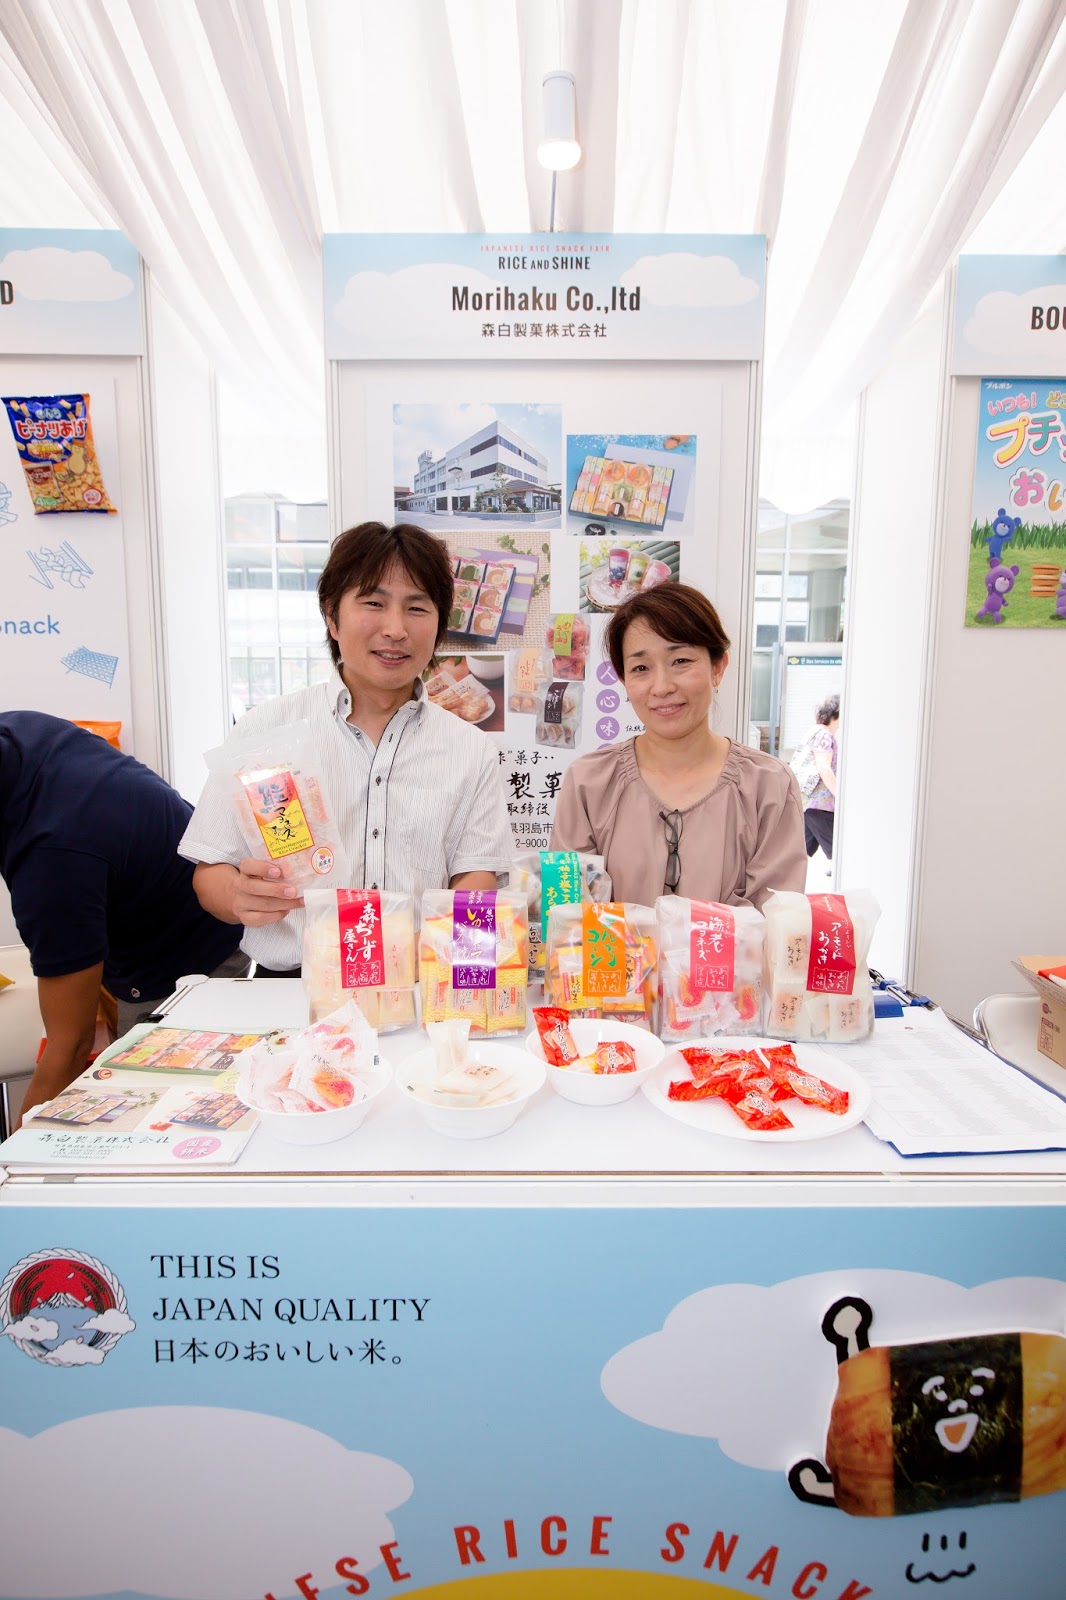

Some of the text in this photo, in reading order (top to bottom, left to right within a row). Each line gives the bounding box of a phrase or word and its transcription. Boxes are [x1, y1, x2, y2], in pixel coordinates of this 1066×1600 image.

[498, 256, 591, 270] RICE AND SHINE
[452, 286, 641, 314] Morihaku Co.,ltd
[481, 323, 608, 338] 森白製菓株式会社
[15, 417, 88, 440] ピーナツあげ
[0, 614, 60, 635] nack
[150, 1254, 280, 1279] THIS IS
[152, 1297, 432, 1325] JAPAN QUALITY
[153, 1337, 402, 1365] 日本のおいしい米。
[264, 1540, 412, 1600] ESE
[453, 1515, 613, 1566] RICE
